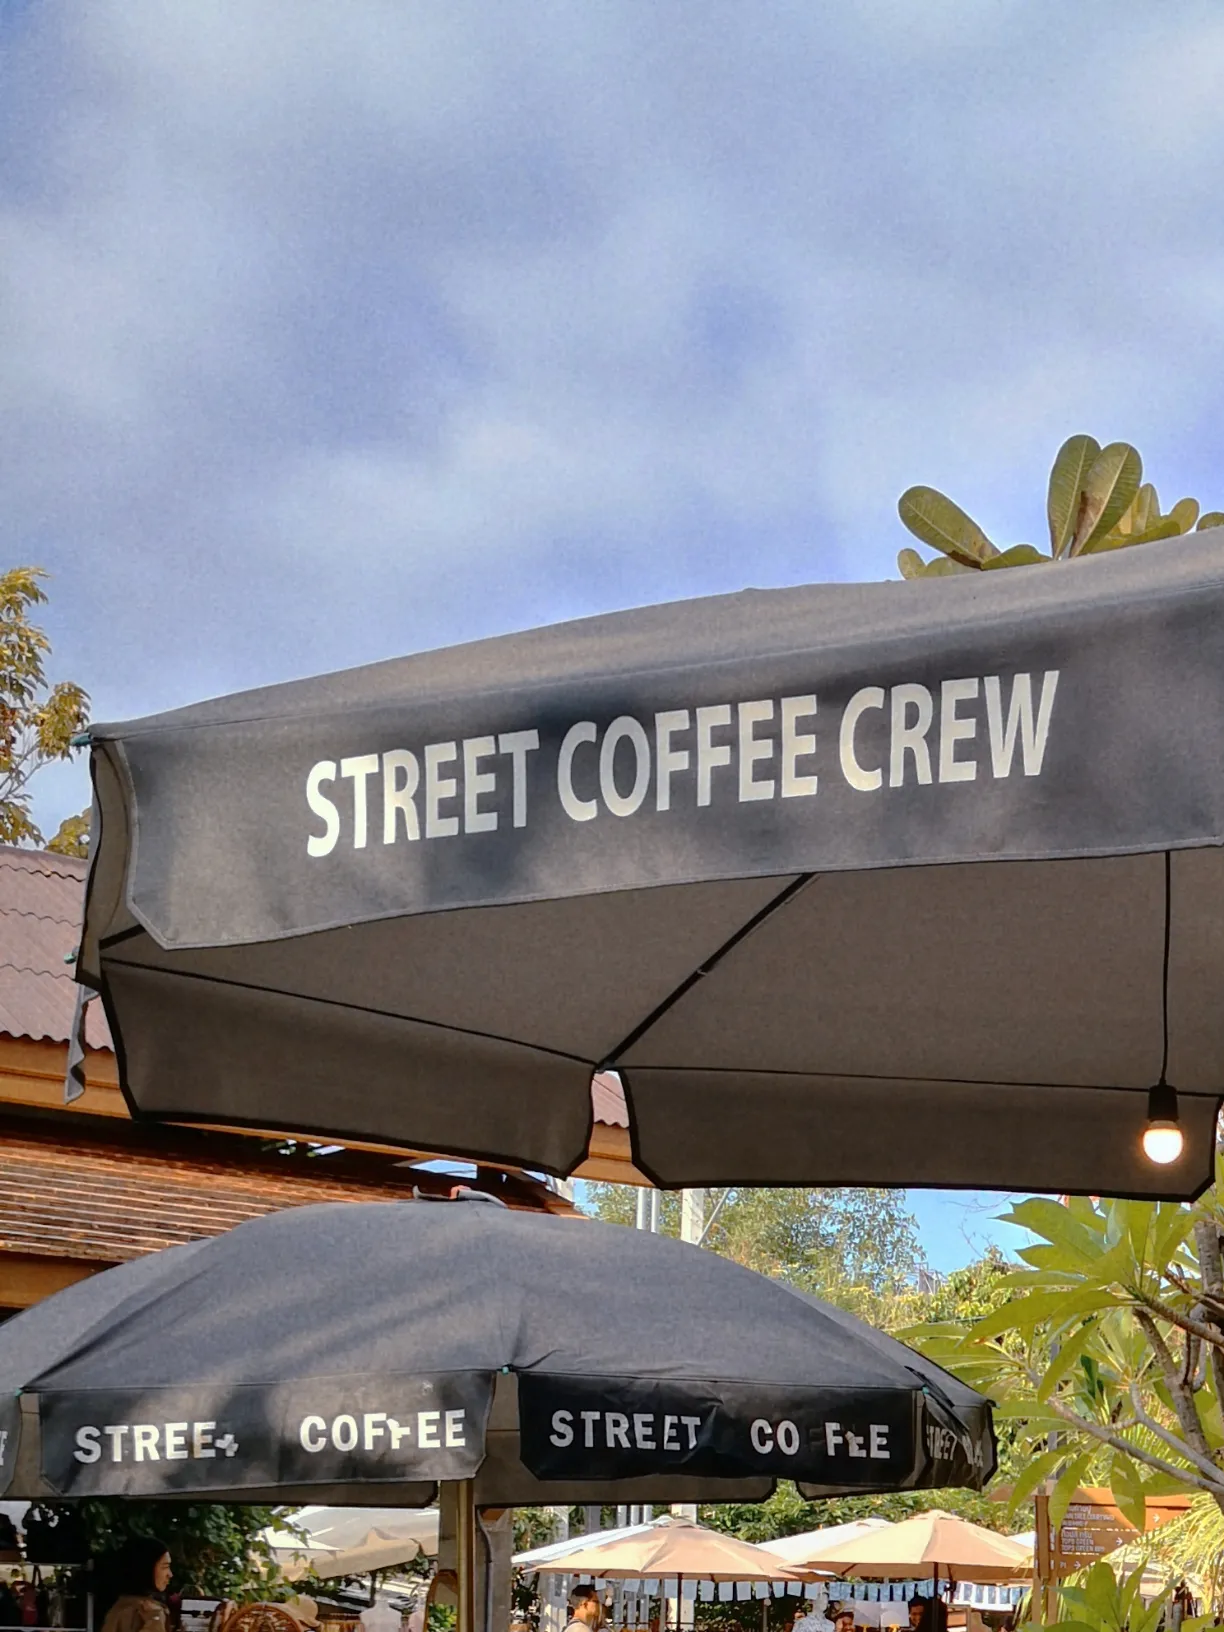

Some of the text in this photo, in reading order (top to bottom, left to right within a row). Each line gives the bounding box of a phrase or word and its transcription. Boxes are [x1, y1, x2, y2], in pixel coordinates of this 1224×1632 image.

[306, 670, 1060, 858] STREET COFFEE CREW
